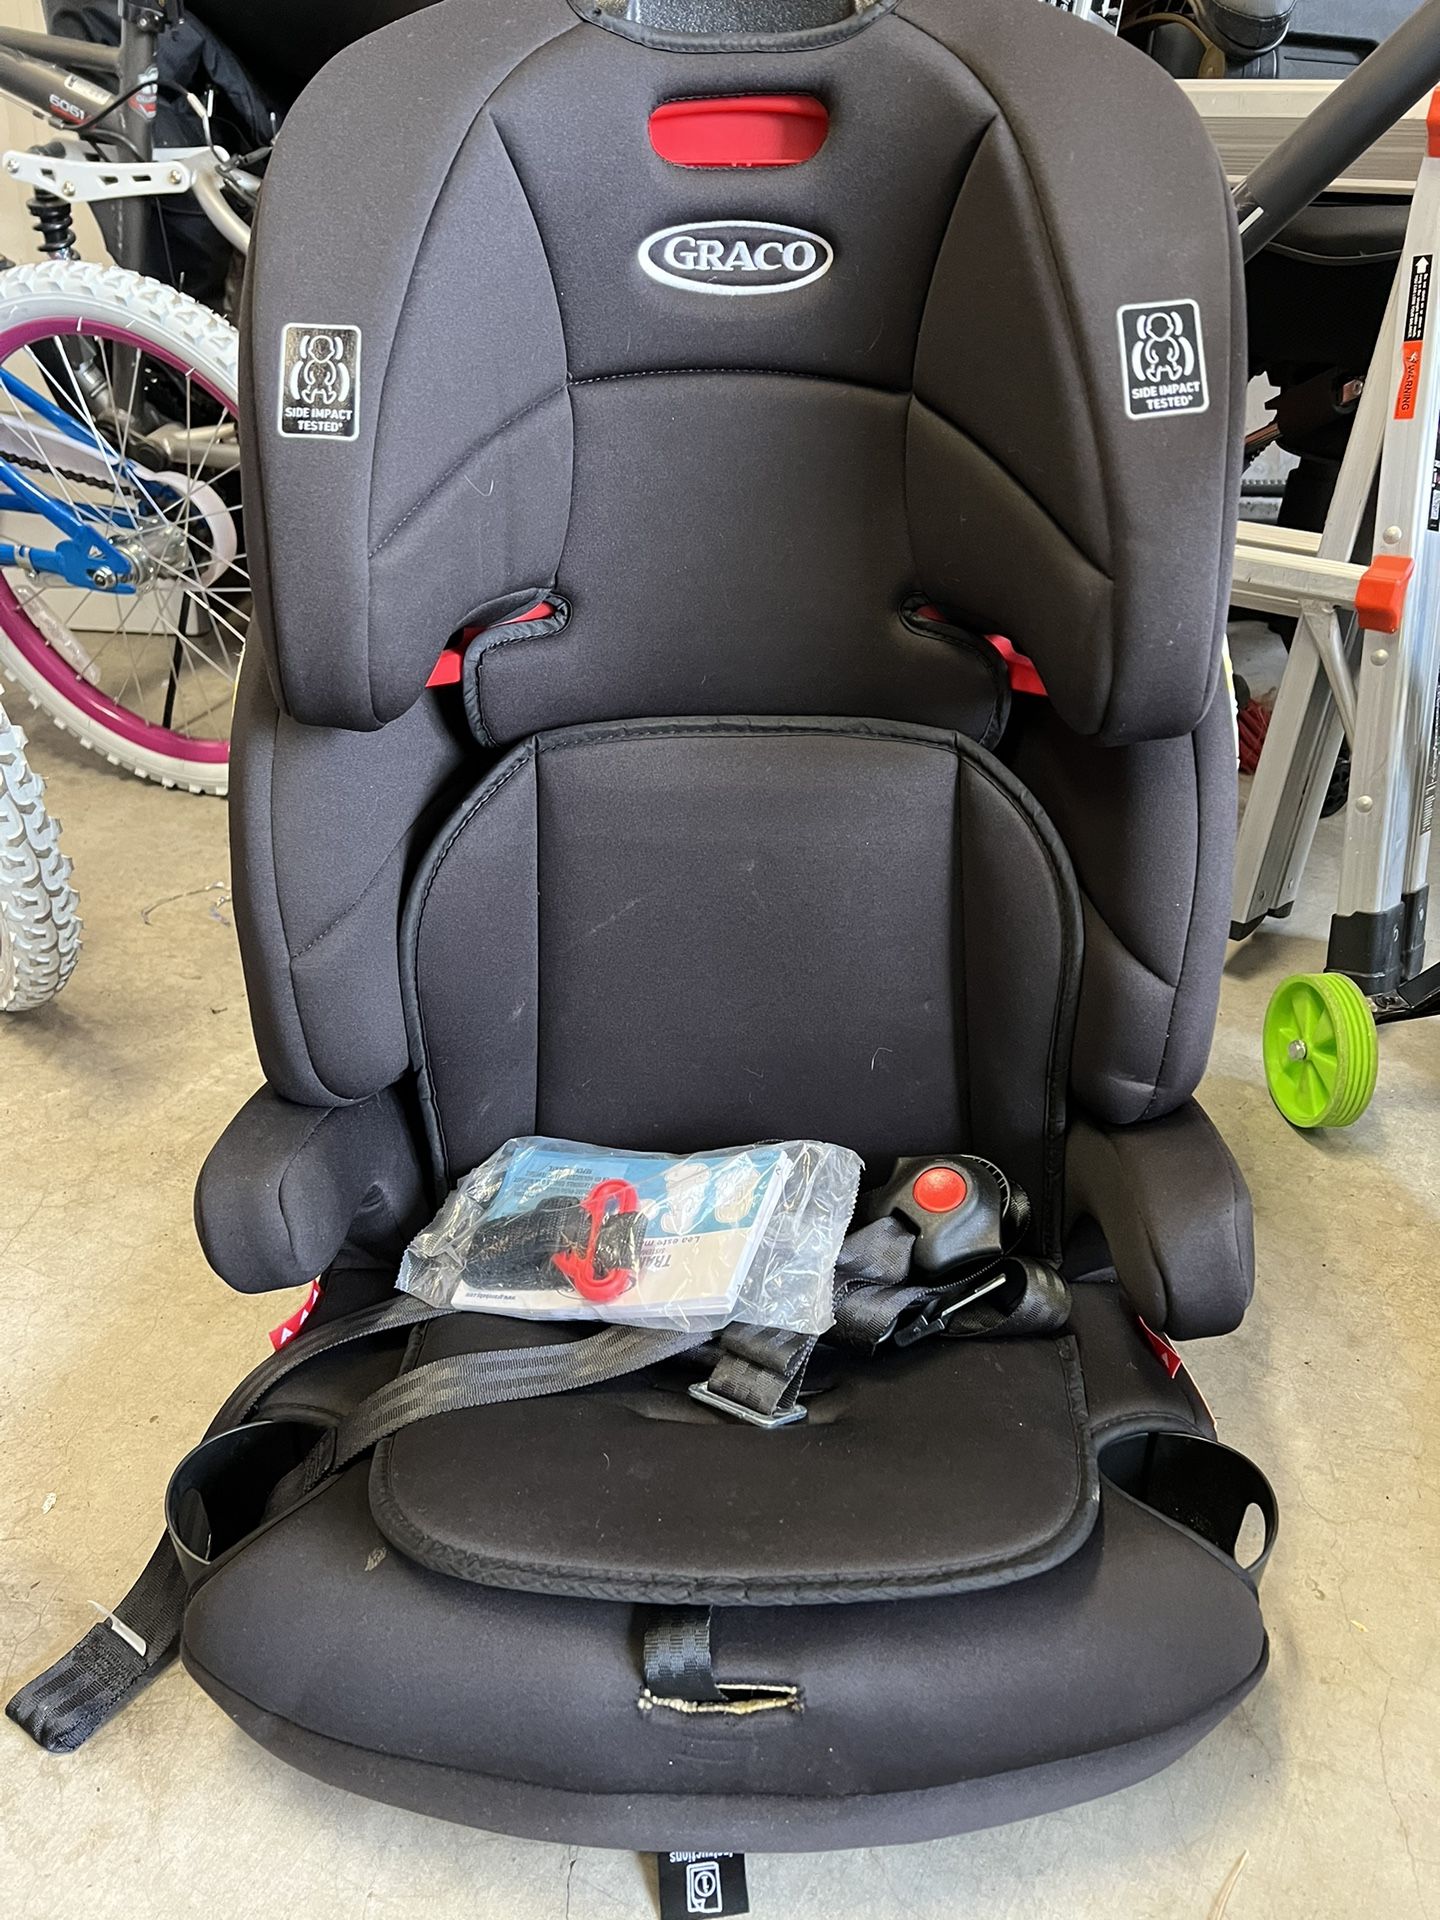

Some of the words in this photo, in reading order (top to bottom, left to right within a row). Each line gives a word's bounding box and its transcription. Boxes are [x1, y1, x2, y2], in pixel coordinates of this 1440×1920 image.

[49, 94, 84, 120] 6061
[663, 235, 817, 272] GRACO
[1131, 385, 1158, 399] SIDE
[1158, 381, 1201, 396] IMPACT
[1402, 364, 1415, 410] WARNING
[284, 406, 311, 418] SIDE
[310, 408, 353, 420] IMPACT
